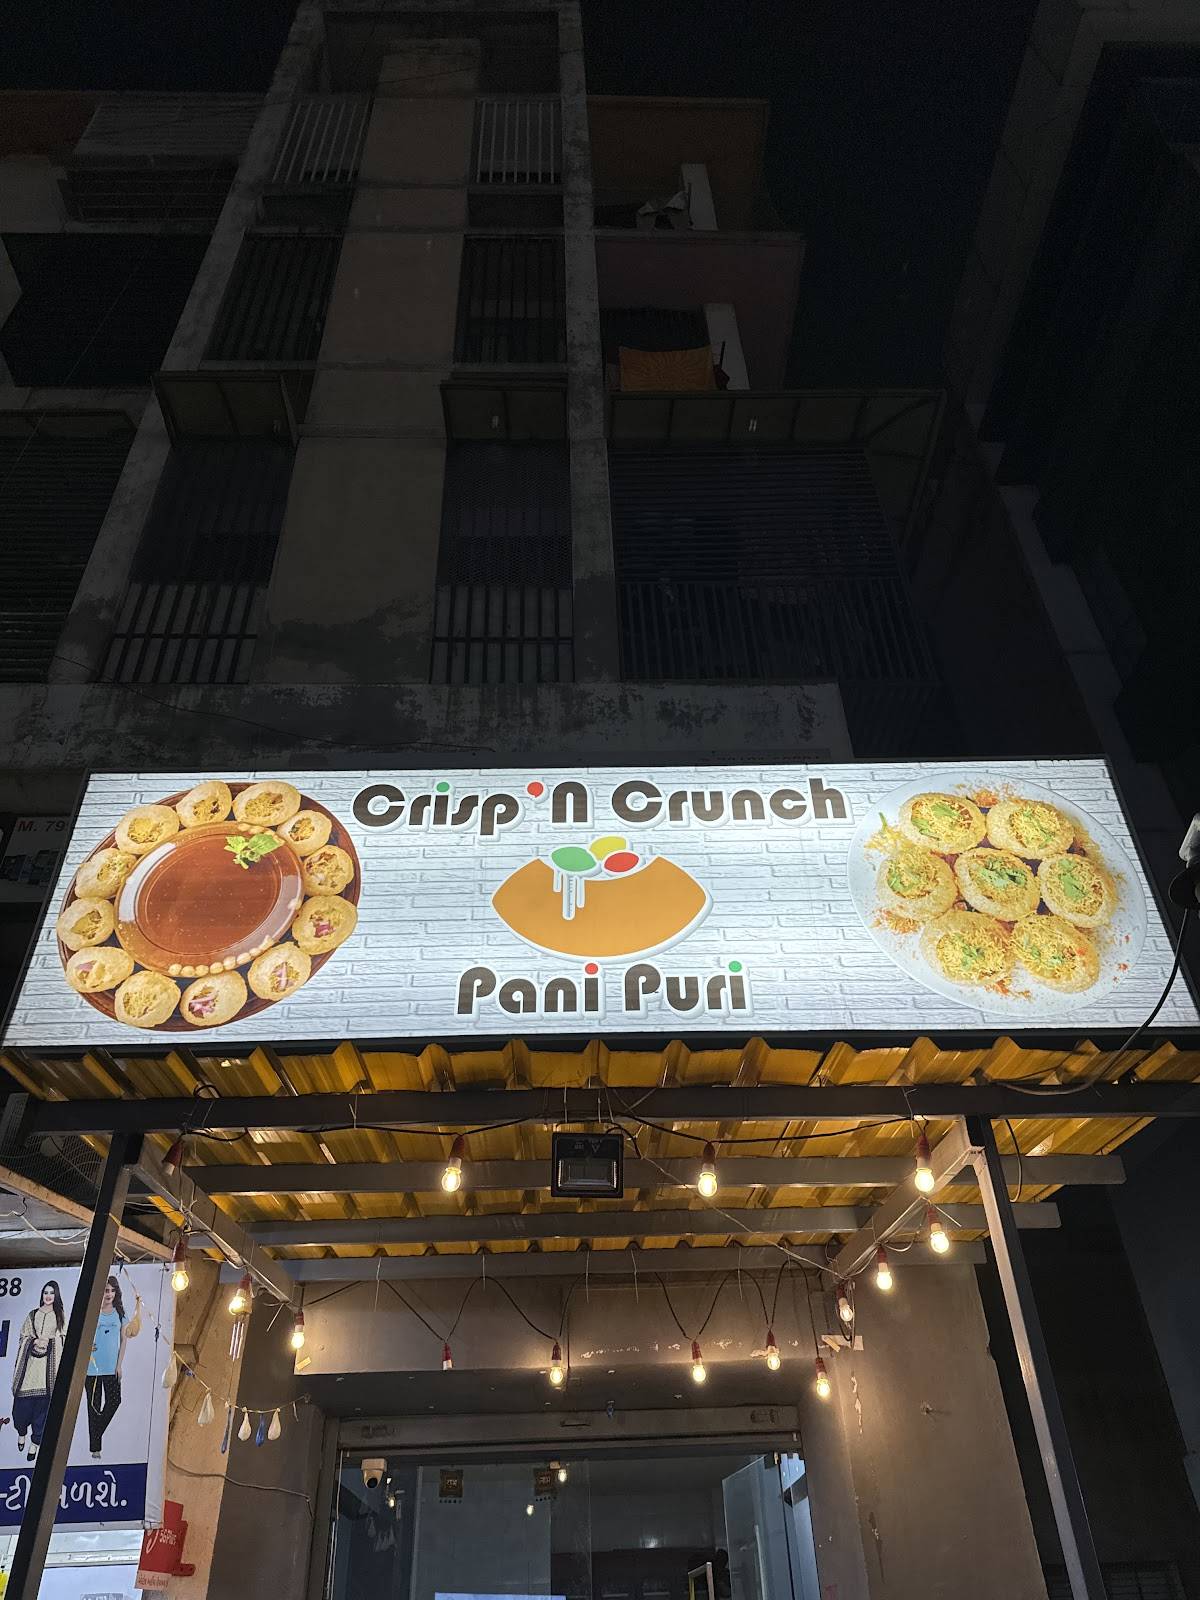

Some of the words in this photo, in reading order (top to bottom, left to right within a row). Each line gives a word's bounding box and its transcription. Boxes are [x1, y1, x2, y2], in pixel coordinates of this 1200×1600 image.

[45, 820, 66, 832] 79
[352, 781, 520, 837] Crisp
[610, 777, 848, 824] Crunch
[457, 962, 599, 1016] Pani
[623, 960, 747, 1013] Puri
